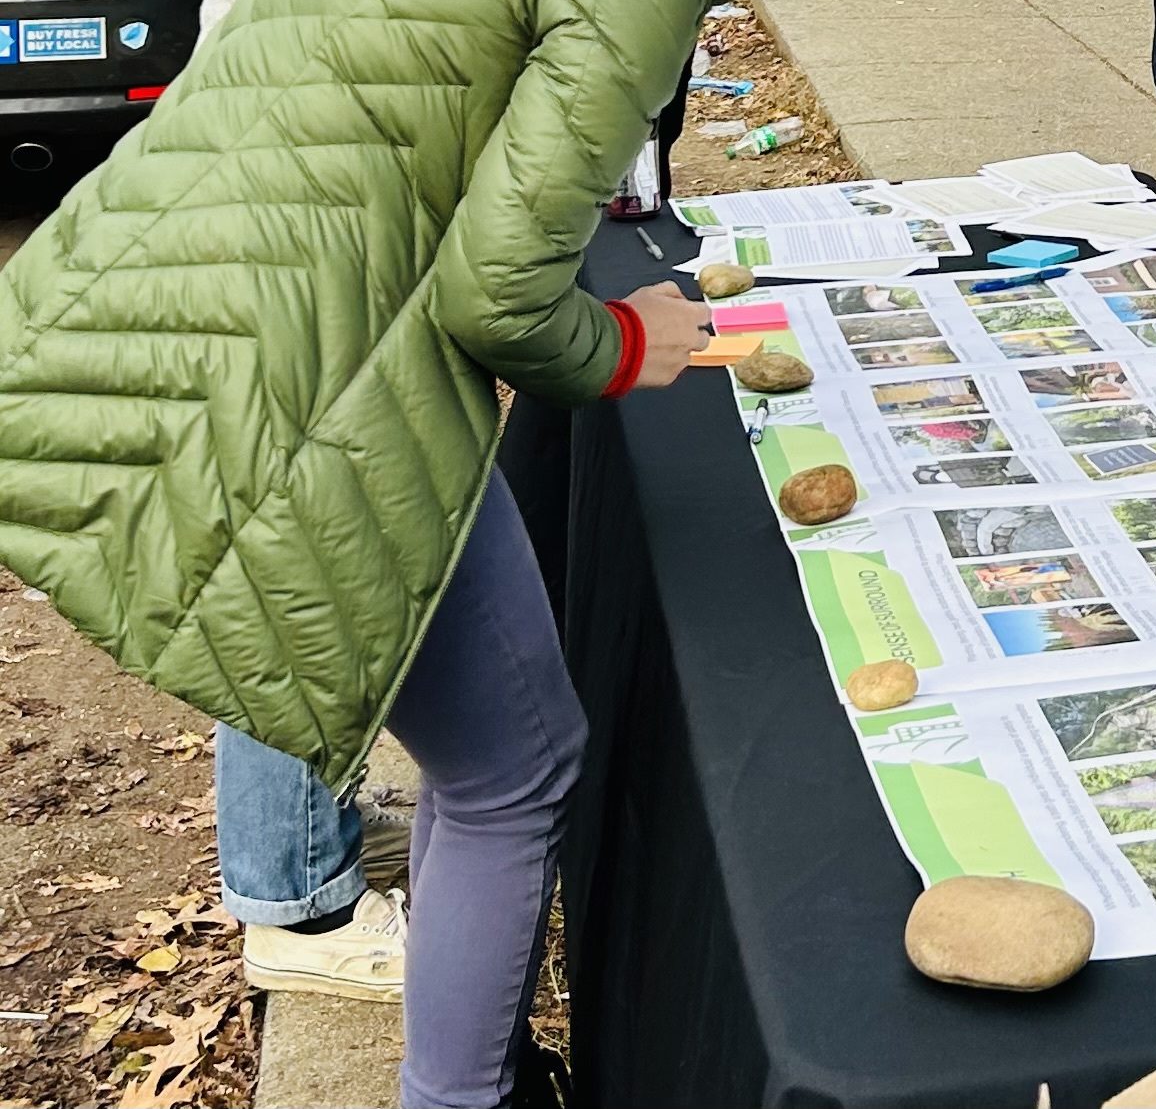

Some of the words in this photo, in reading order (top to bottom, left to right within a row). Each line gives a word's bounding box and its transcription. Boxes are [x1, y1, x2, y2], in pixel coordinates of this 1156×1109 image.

[26, 30, 53, 41] BUY
[56, 28, 98, 39] FRESH
[26, 41, 53, 51] BUY
[56, 39, 100, 50] LOCAL
[858, 570, 896, 621] SURROUND
[878, 621, 901, 631] OF
